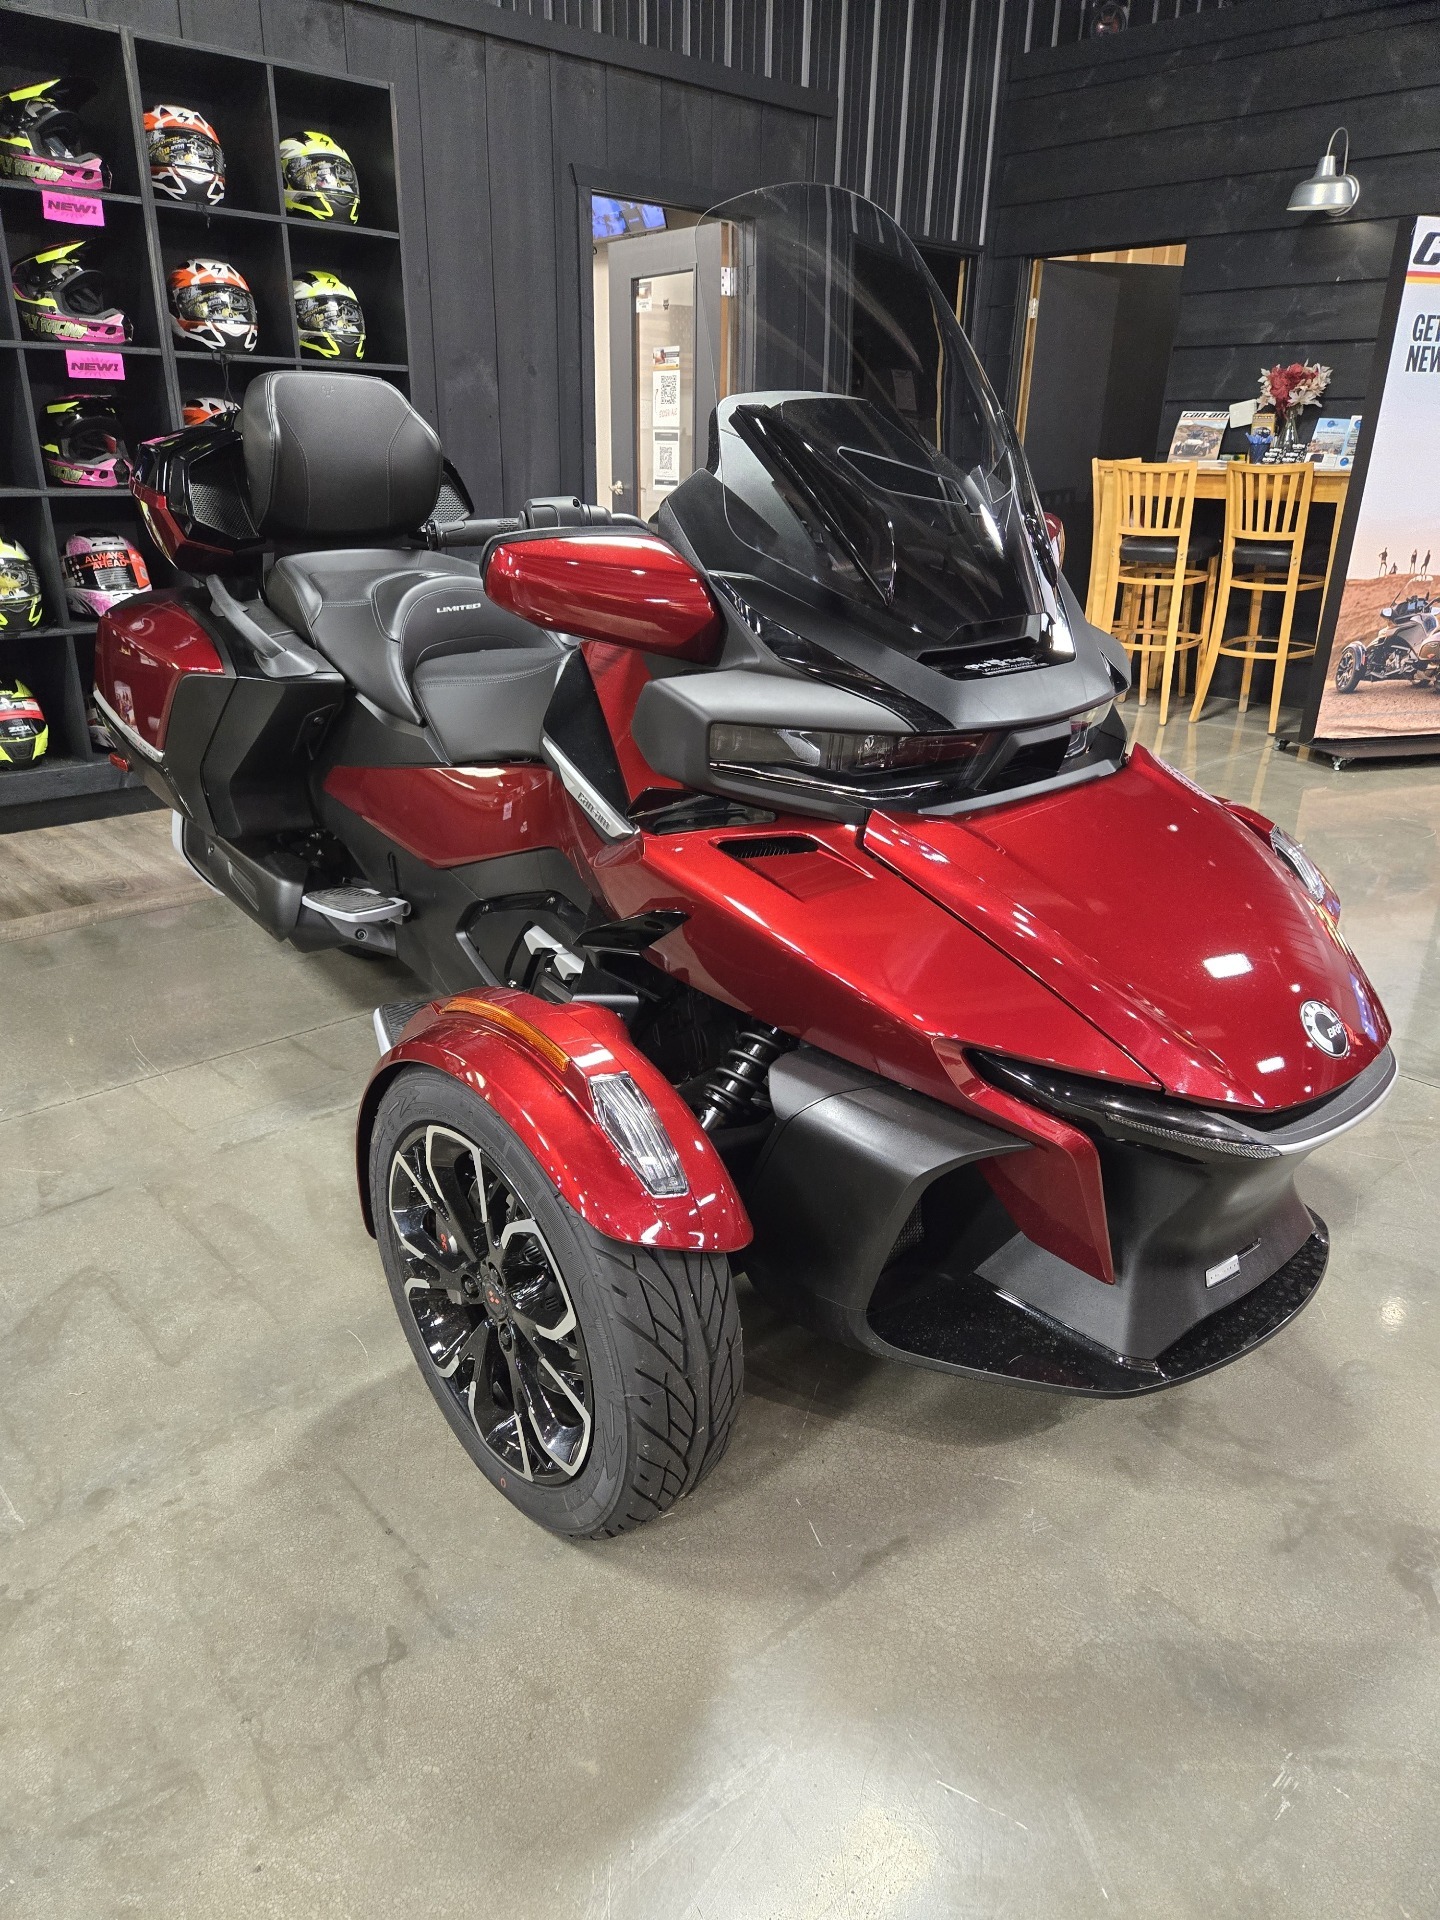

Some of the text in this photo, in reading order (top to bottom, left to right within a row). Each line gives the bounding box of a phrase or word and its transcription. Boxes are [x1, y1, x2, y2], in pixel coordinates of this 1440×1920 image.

[47, 199, 98, 215] NEW!
[71, 362, 119, 372] NEW!
[85, 551, 125, 564] ALWAYS
[93, 558, 128, 571] AHEAD
[436, 602, 481, 613] LIMITED
[577, 792, 611, 831] can-am
[1326, 1022, 1343, 1039] BRP
